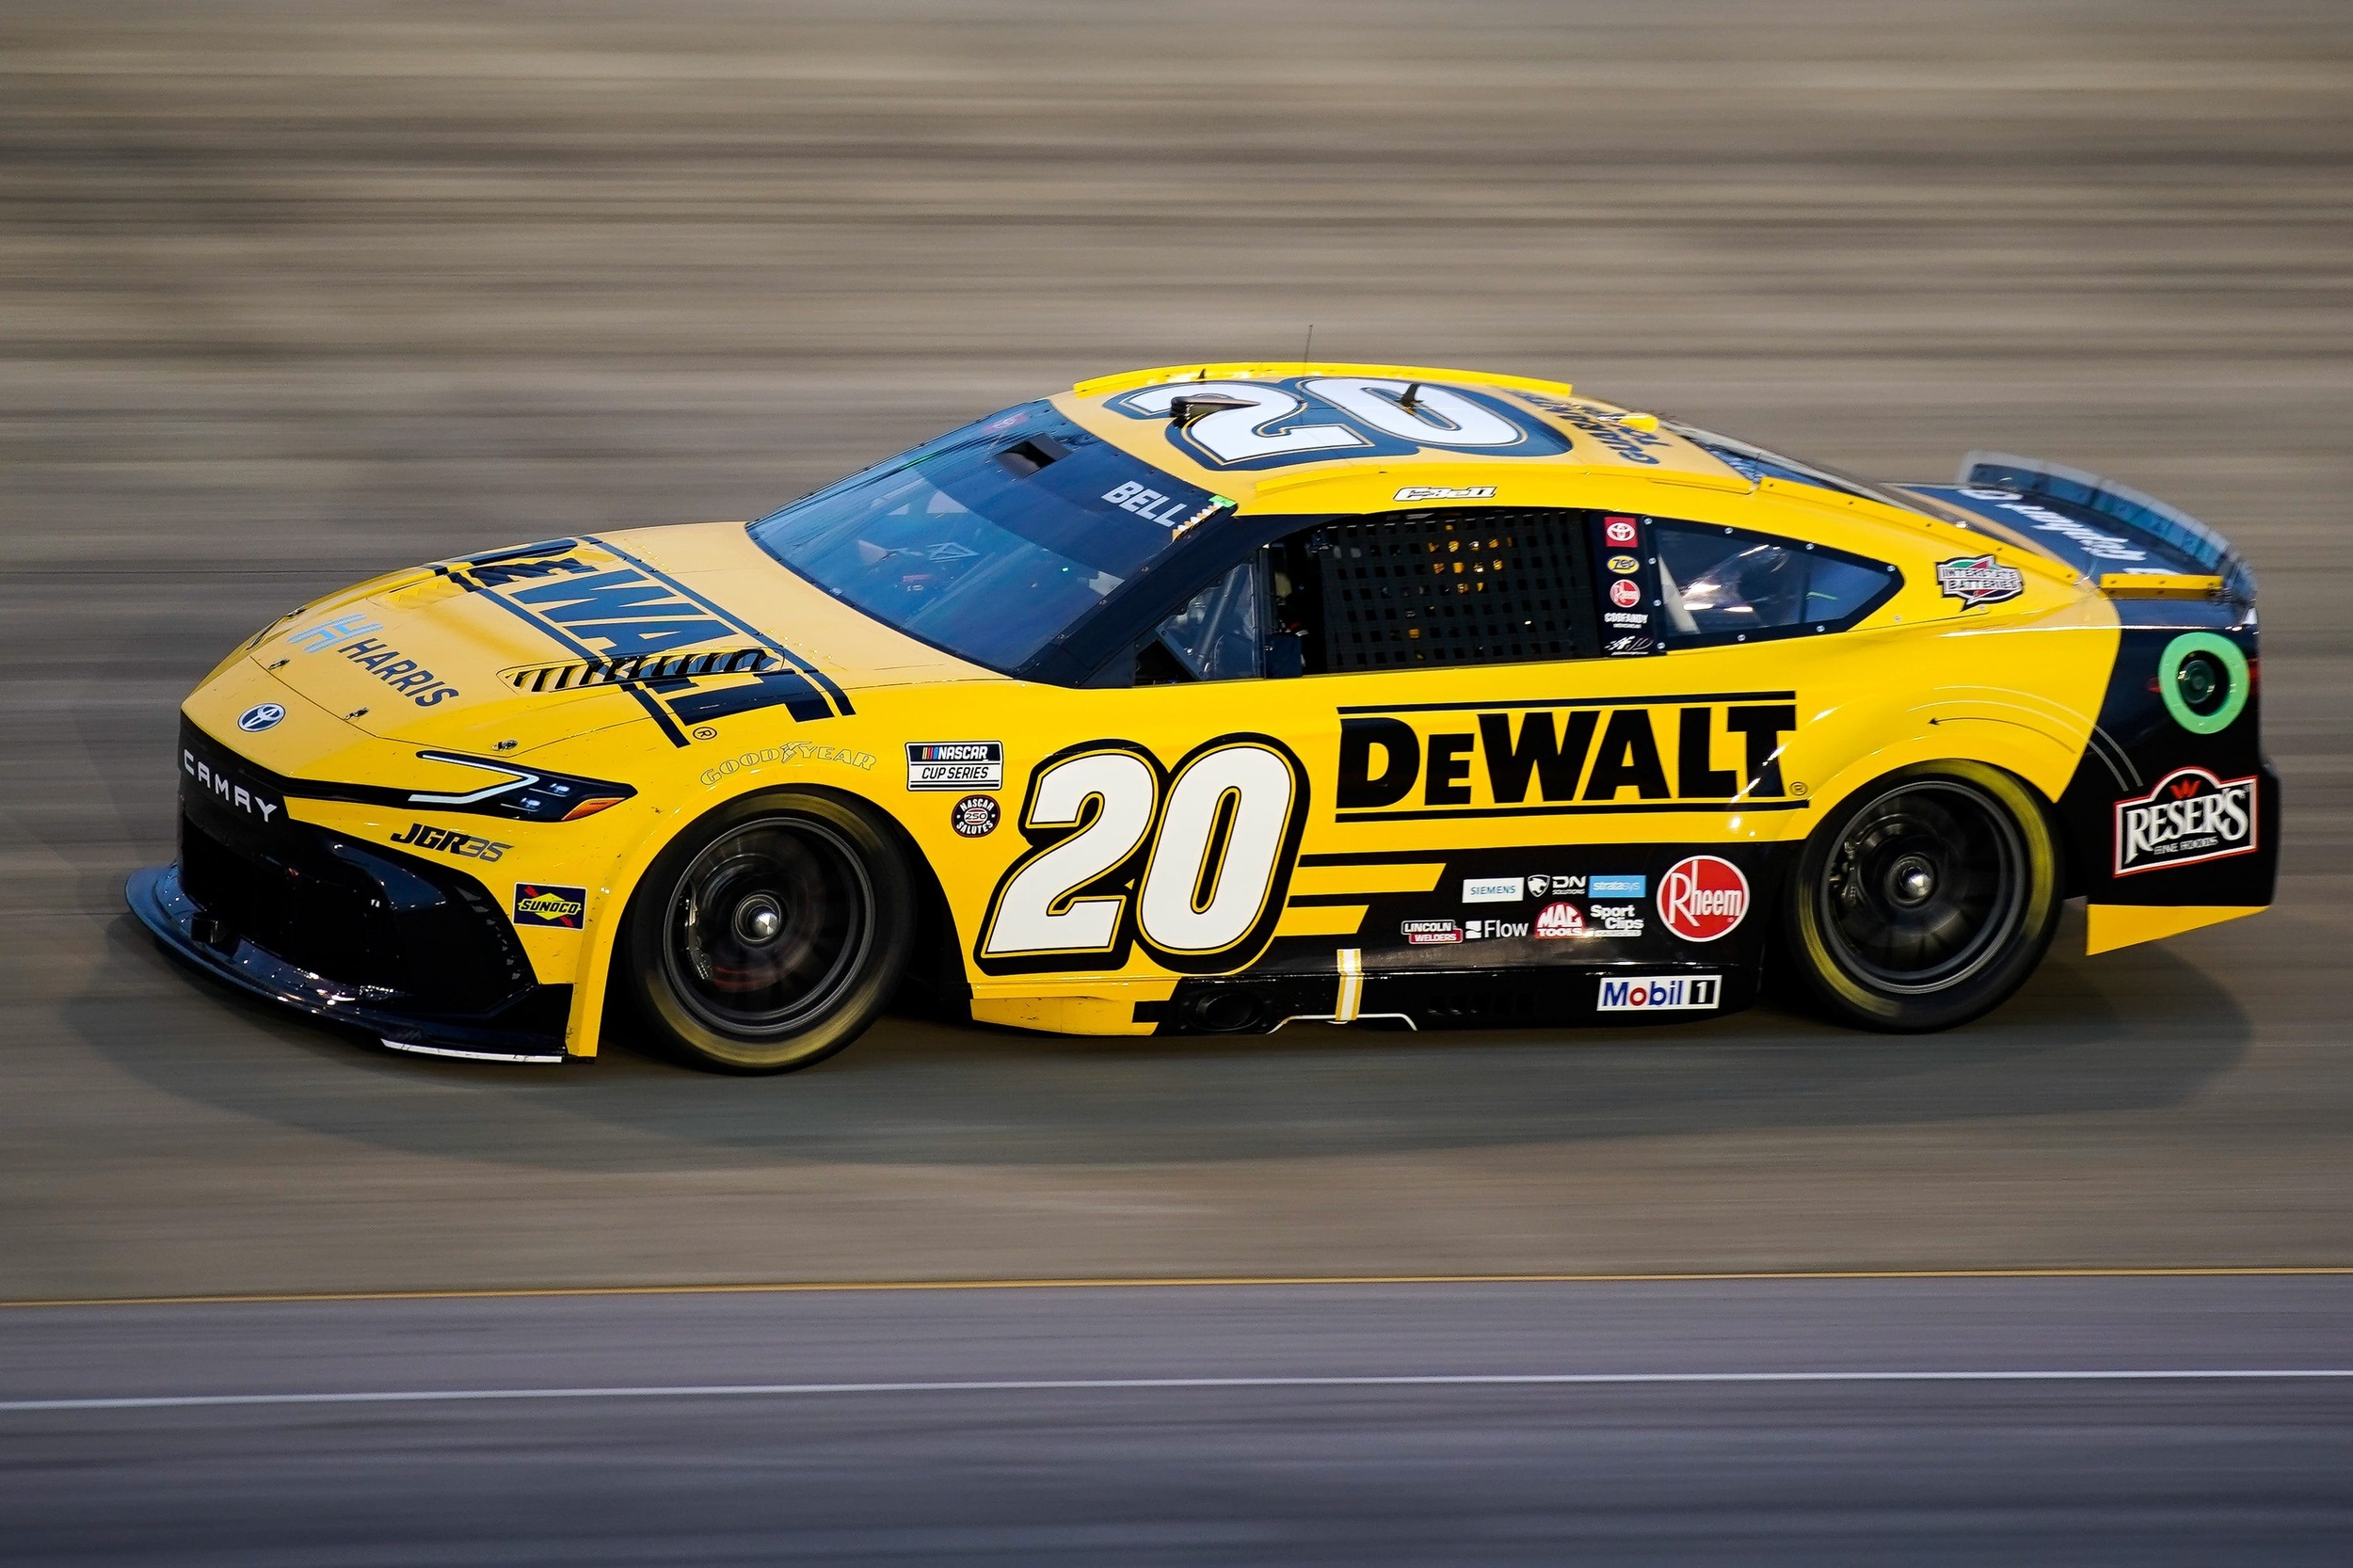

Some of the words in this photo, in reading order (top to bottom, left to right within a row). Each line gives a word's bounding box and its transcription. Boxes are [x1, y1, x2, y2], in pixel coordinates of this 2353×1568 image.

[1118, 377, 1527, 466] 20
[1101, 480, 1188, 527] BELL
[337, 637, 459, 707] HARRIS
[937, 745, 989, 760] NASCAR
[699, 741, 877, 787] GOODYEAR
[921, 766, 946, 780] CUP
[947, 766, 989, 779] SERIES
[183, 748, 278, 824] CAMRY
[959, 797, 996, 812] NASCAR
[965, 812, 987, 821] 250
[955, 820, 994, 835] SALUTES
[2124, 787, 2249, 865] RESER'S
[981, 740, 1298, 959] 20
[1551, 875, 1587, 888] DN
[1592, 881, 1641, 892] stratasys
[1469, 885, 1517, 896] SIEMENS
[1668, 859, 1743, 927] Rheem
[520, 899, 582, 915] SUNOCO
[1590, 904, 1636, 920] Sport
[1537, 907, 1583, 928] MAC
[1604, 917, 1645, 931] Clips
[1403, 921, 1453, 934] LINCOLN
[1484, 920, 1529, 938] Flow
[1536, 928, 1583, 937] TOOLS
[1415, 933, 1458, 943] WELDERS
[1602, 980, 1685, 1007] Mobil
[1695, 981, 1708, 1004] 1
